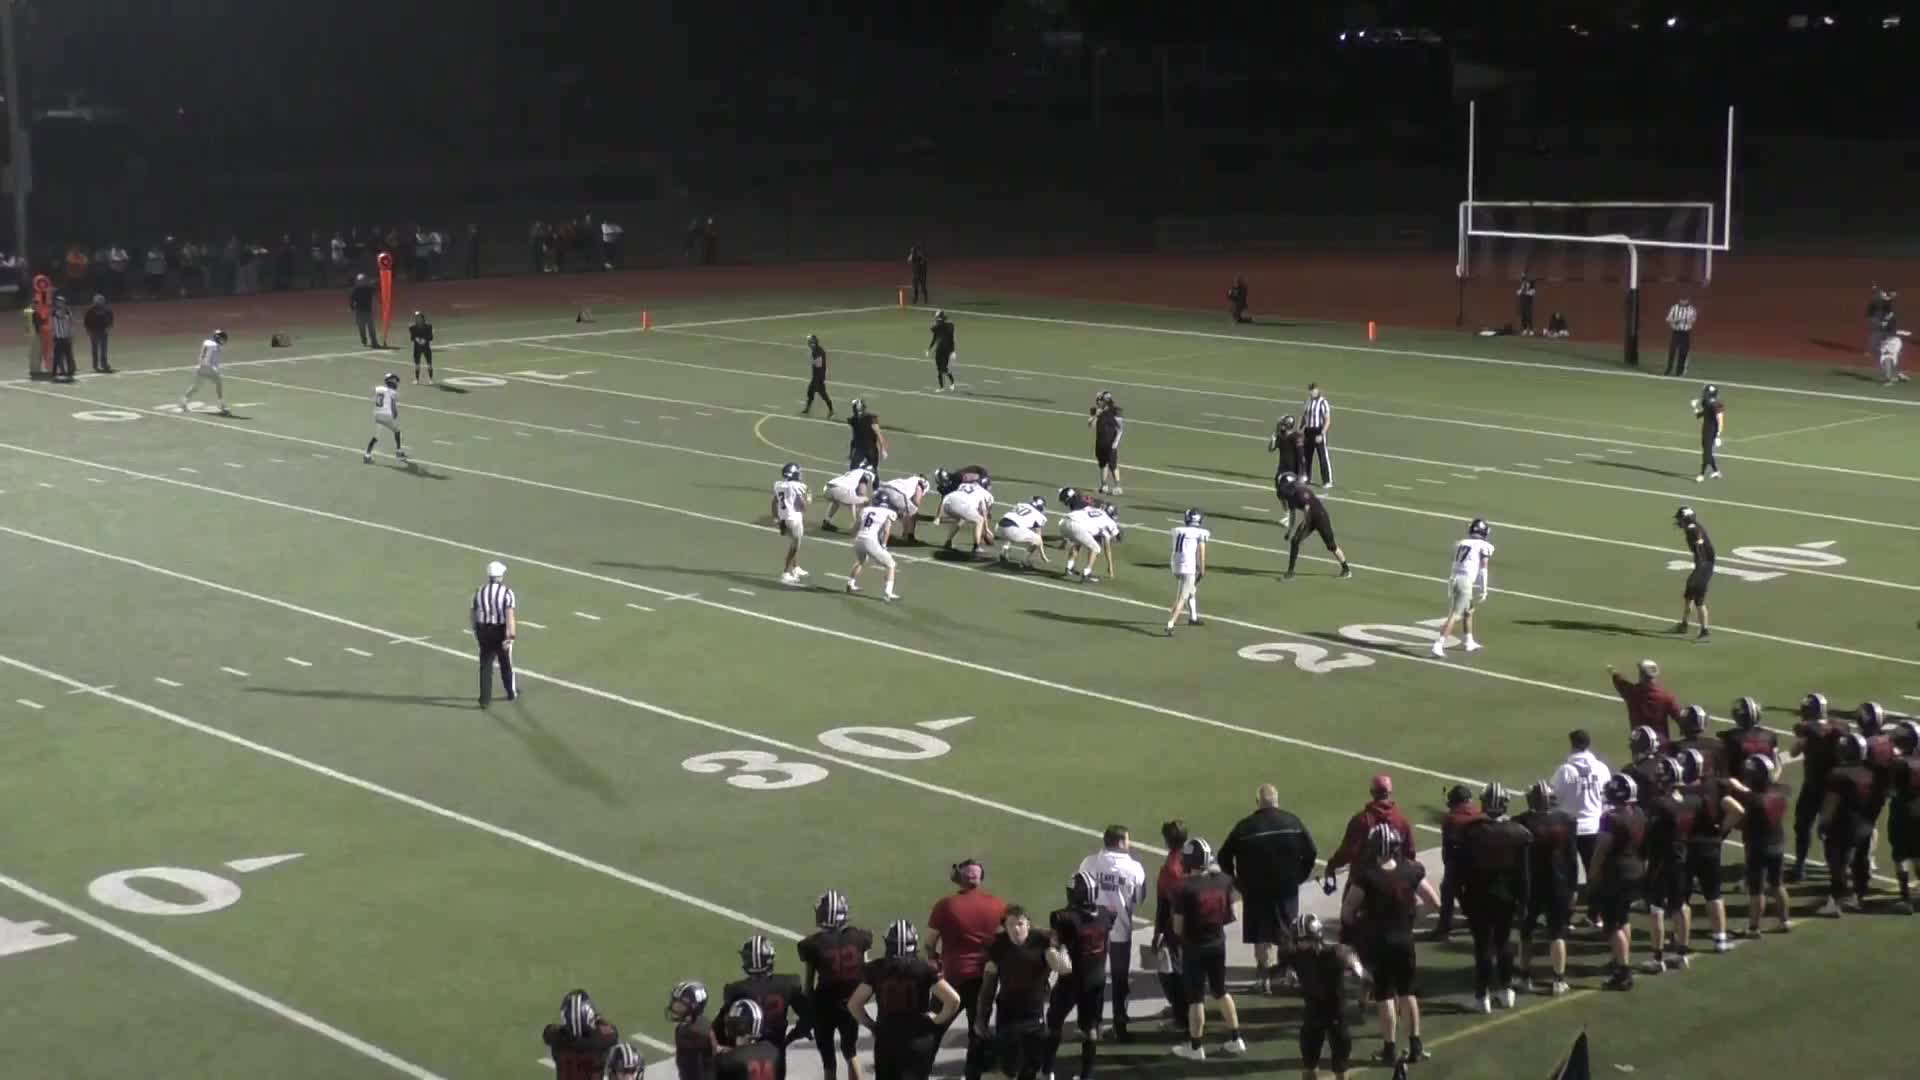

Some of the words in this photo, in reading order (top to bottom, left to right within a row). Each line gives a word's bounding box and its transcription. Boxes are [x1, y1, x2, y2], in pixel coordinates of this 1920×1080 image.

[865, 511, 877, 528] 6
[1175, 533, 1186, 553] 11
[1455, 544, 1472, 563] 17
[1237, 624, 1462, 673] 20
[681, 726, 952, 790] 30
